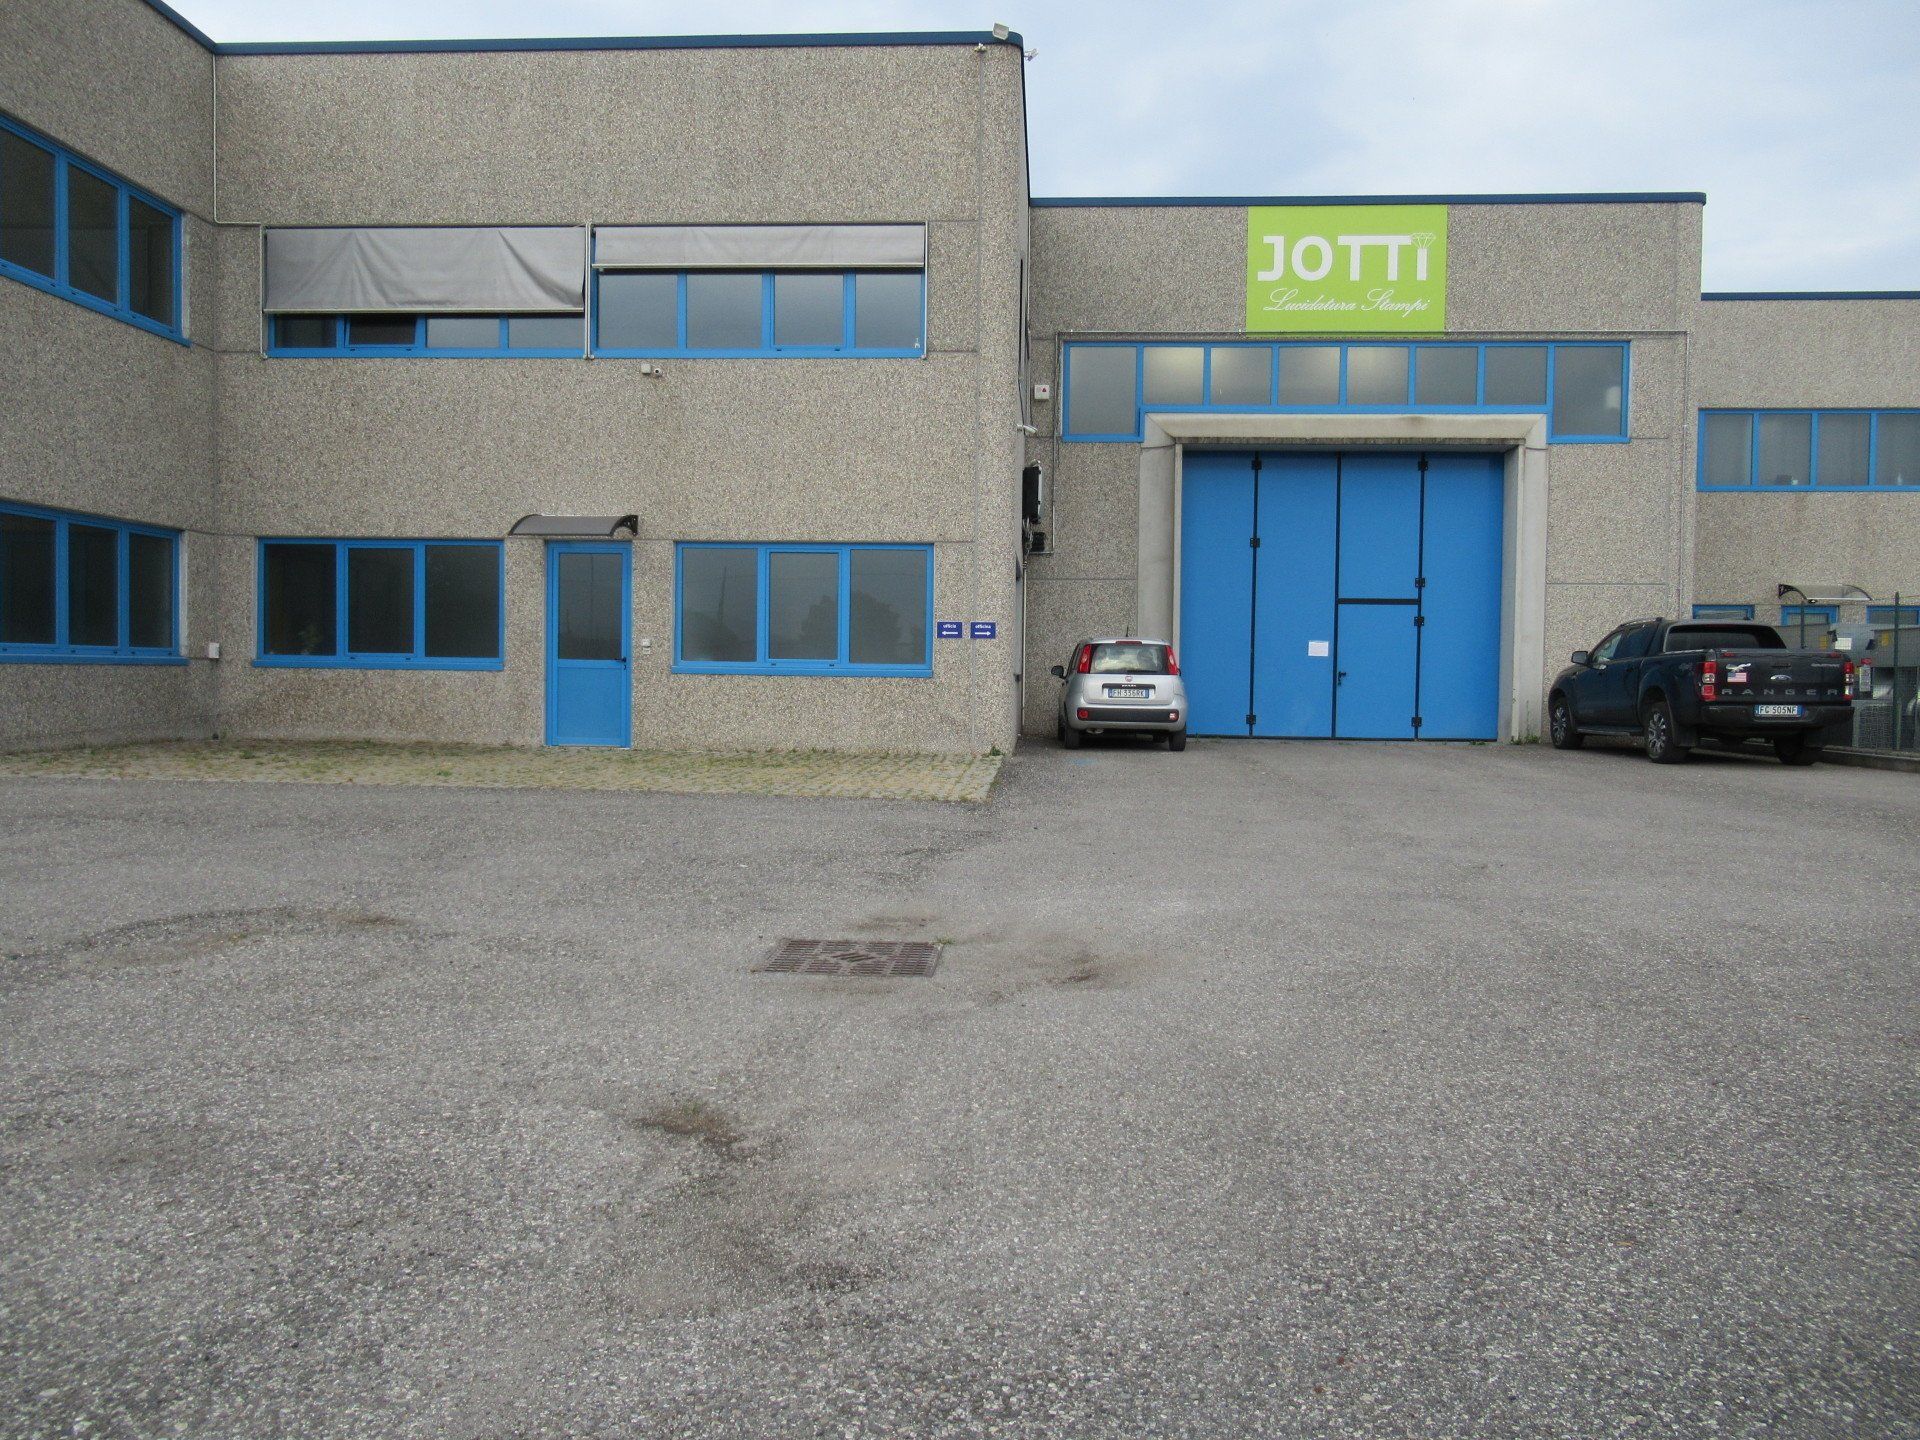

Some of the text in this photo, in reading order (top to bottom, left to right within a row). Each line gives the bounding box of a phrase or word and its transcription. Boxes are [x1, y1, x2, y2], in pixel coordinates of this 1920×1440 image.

[1262, 287, 1431, 318] Lucidatura Stampi
[1721, 688, 1838, 696] RANGER
